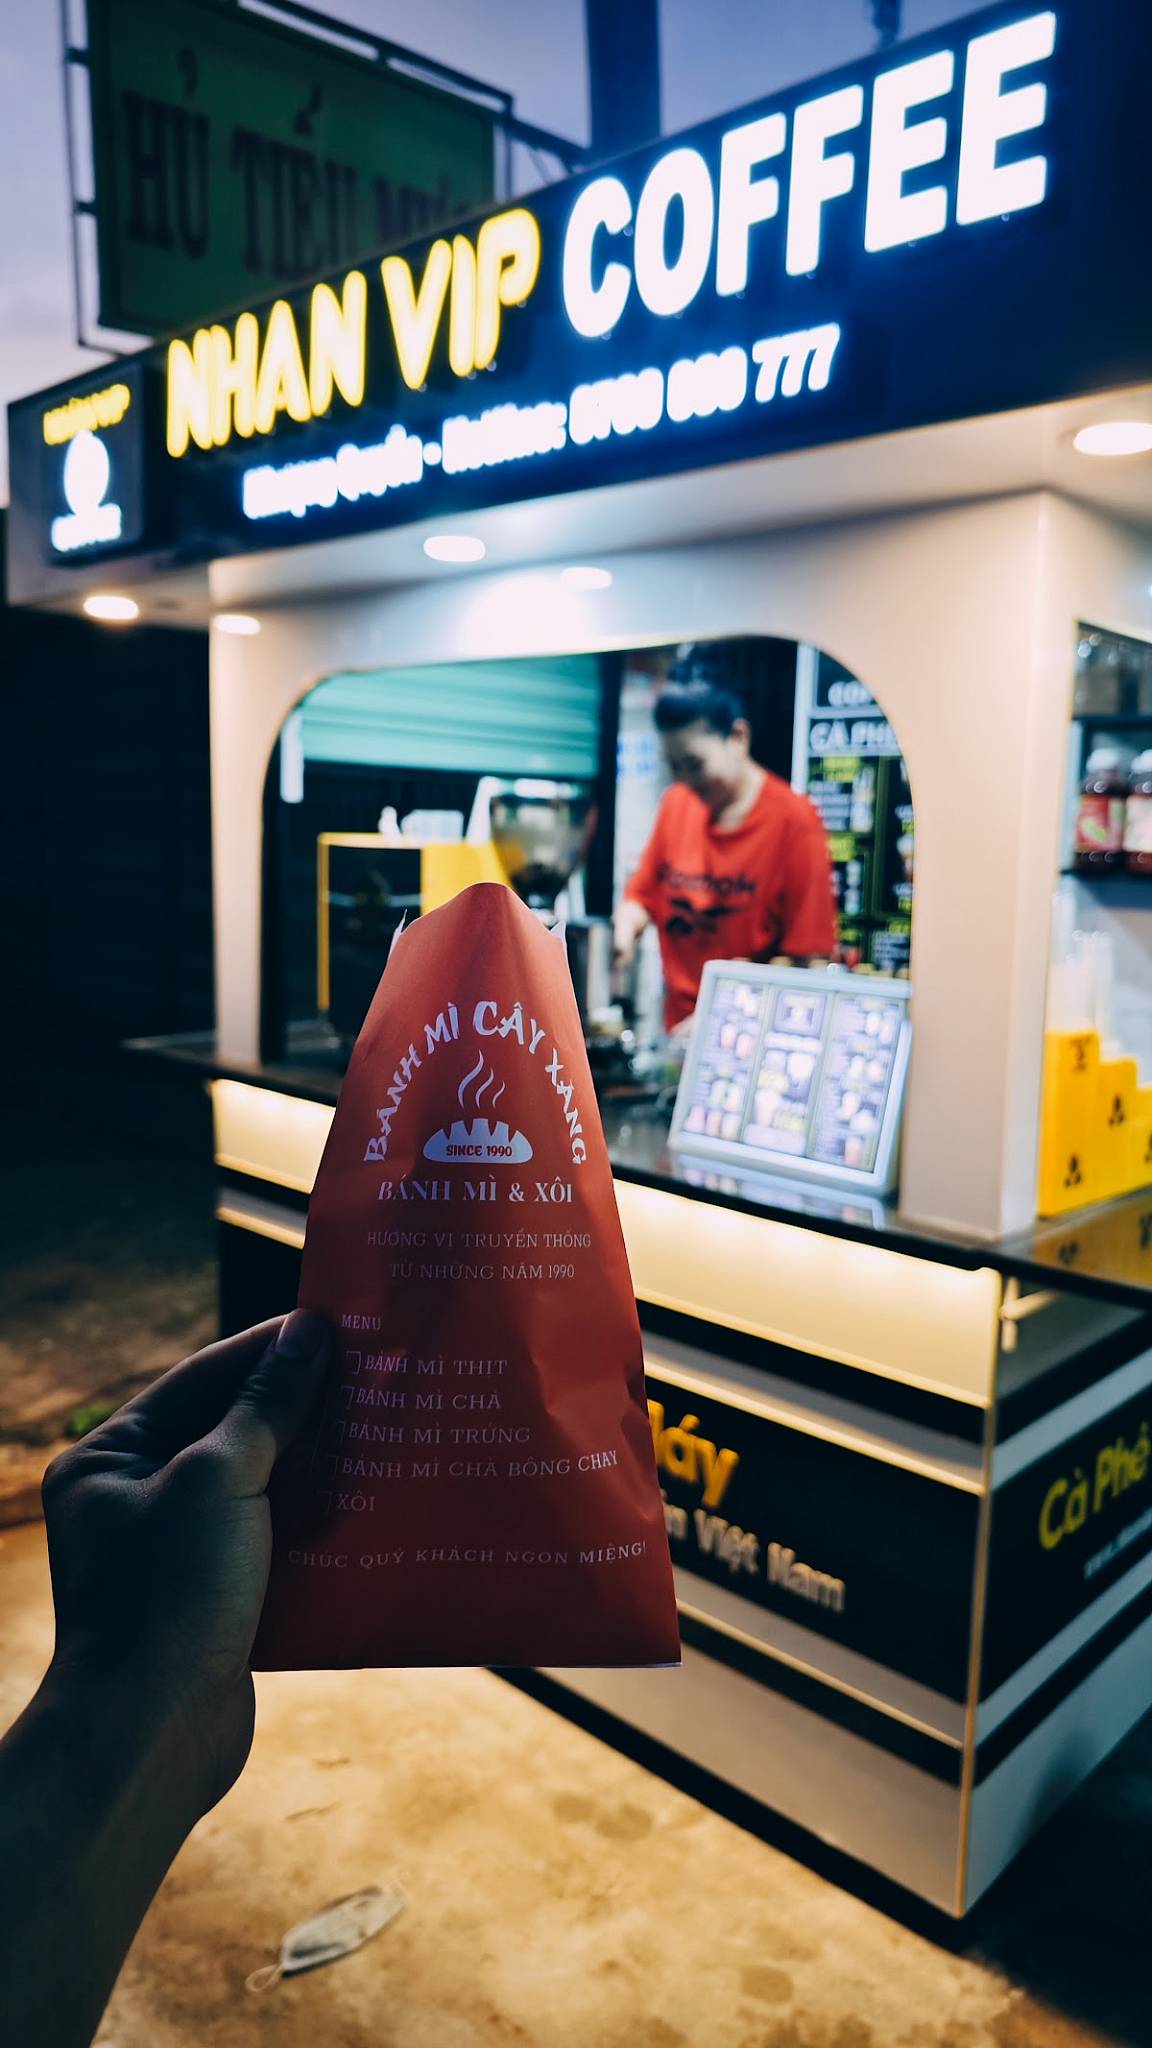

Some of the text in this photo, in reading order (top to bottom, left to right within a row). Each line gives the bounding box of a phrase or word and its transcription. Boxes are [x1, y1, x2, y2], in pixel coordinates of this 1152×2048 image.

[166, 270, 367, 458] NHAN
[380, 208, 541, 390] VIP
[562, 11, 1057, 338] COFFEE
[752, 322, 841, 404] 777
[423, 1002, 459, 1055] MÌ
[473, 1000, 546, 1055] CÂY
[446, 1144, 513, 1157] SINCE 1990
[378, 1173, 573, 1203] BÁNH MÌ & XÔI
[502, 1261, 543, 1280] NĂM
[548, 1262, 575, 1280] 1990
[341, 1314, 382, 1331] MENU
[365, 1350, 408, 1374] BÁNH
[416, 1354, 445, 1376] MÌ
[355, 1384, 405, 1409] BÁNH
[415, 1390, 444, 1410] MÌ
[348, 1418, 404, 1444] BÁNH
[412, 1423, 441, 1444] MÌ
[342, 1453, 401, 1478] BÁNH
[411, 1458, 439, 1478] MÌ
[507, 1456, 571, 1478] BÔNG
[577, 1449, 619, 1473] CHAY
[337, 1491, 376, 1512] XÔI
[505, 1550, 569, 1564] NGON
